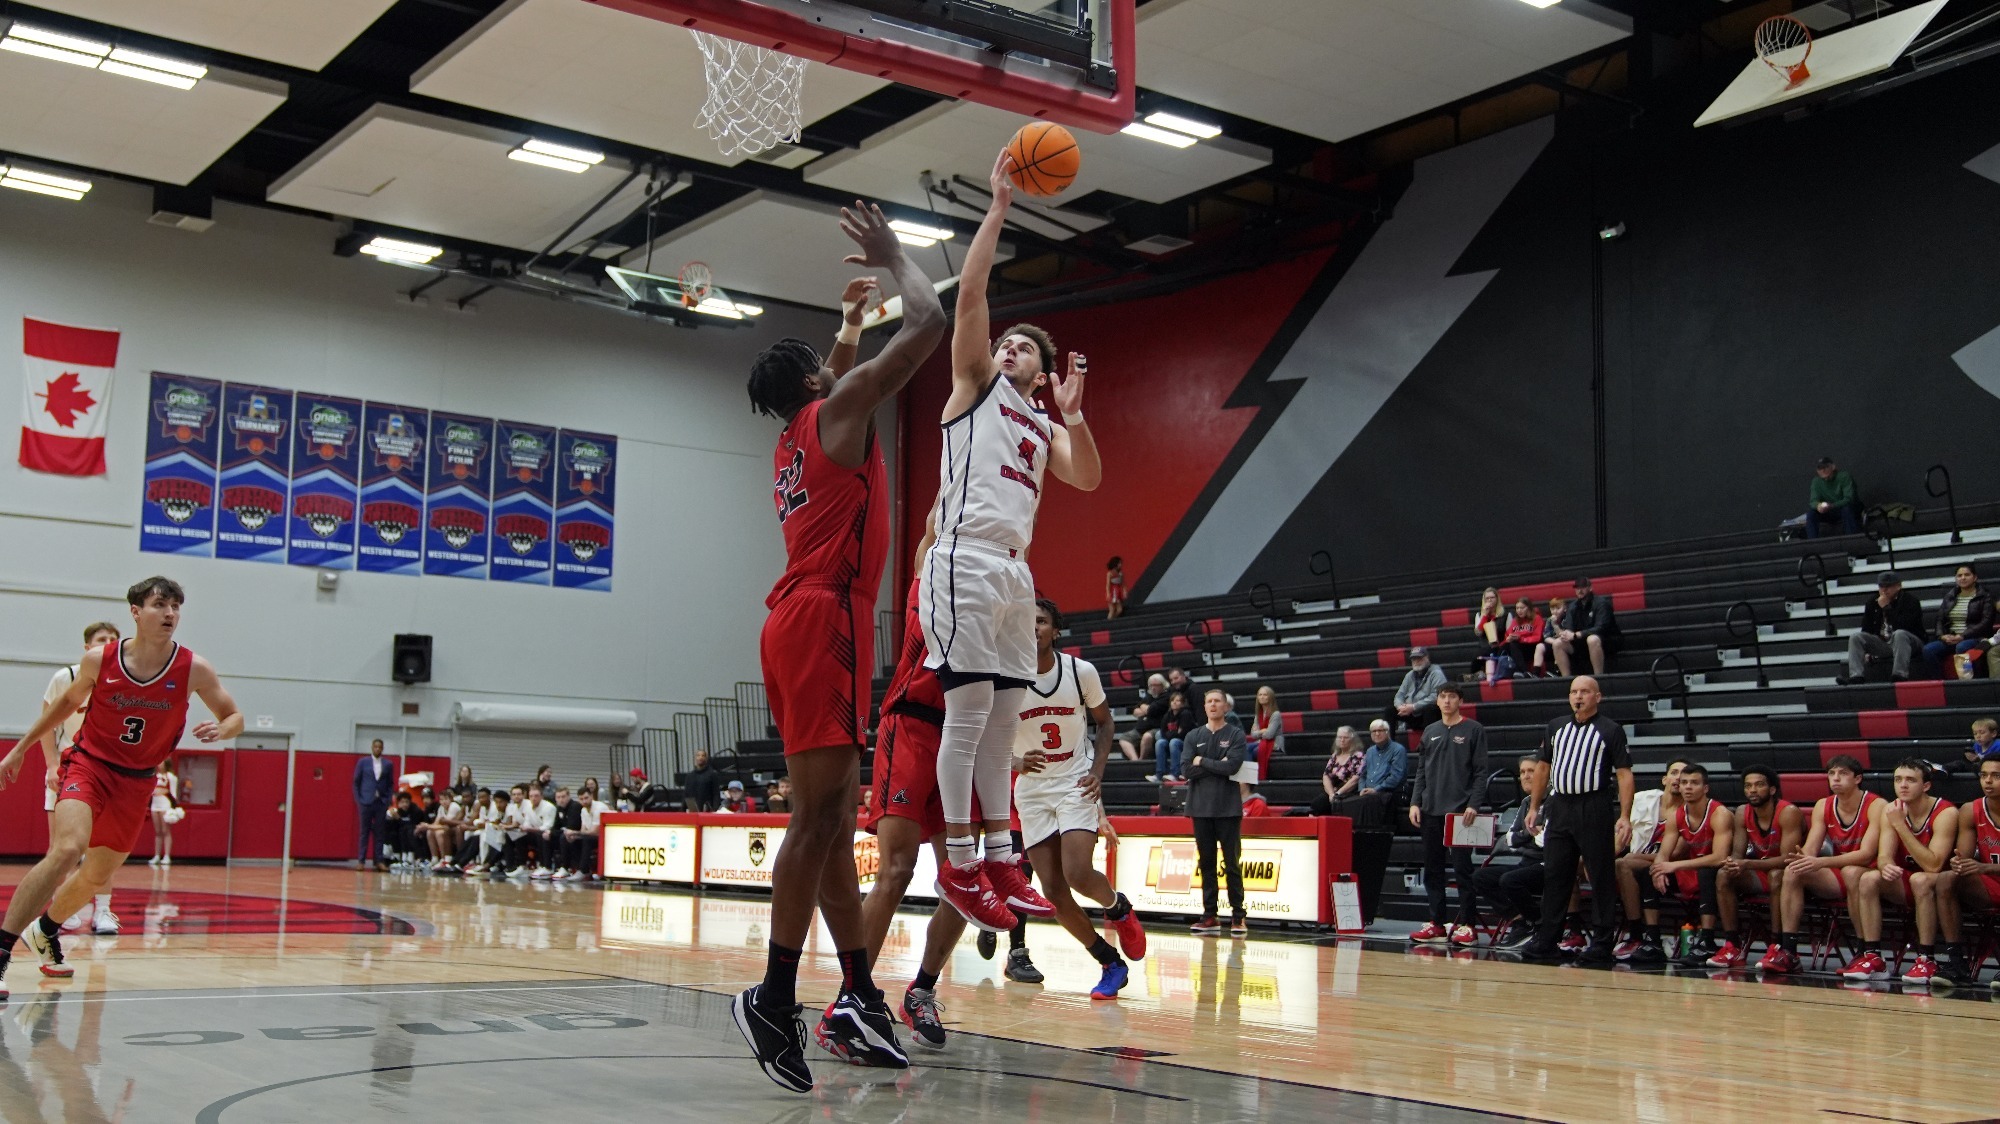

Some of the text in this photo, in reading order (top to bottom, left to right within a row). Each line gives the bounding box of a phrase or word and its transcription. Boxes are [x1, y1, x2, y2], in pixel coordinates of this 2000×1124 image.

[313, 411, 342, 425] gnac
[448, 430, 474, 442] gnac
[511, 437, 538, 449] gnac
[447, 446, 474, 457] FINAL
[574, 446, 600, 459] gnac
[448, 455, 474, 466] FOUR
[574, 463, 602, 473] SWEET
[143, 524, 211, 540] WESTERN OREGON
[219, 532, 284, 546] WESTERN OREGON
[291, 539, 353, 552] WESTERN OREGON
[360, 546, 419, 559] WESTERN OREGON
[428, 550, 485, 563] WESTERN OREGON
[494, 556, 548, 569] WESTERN OREGON
[557, 563, 610, 576] WESTERN OREGON
[1019, 706, 1075, 721] WESTERN
[119, 716, 146, 745] 3
[1041, 723, 1062, 749] 3
[622, 845, 666, 874] maps
[1161, 848, 1194, 878] Tires
[704, 868, 773, 882] WOLVESLOCKERR
[1164, 898, 1202, 909] supporte
[1250, 900, 1290, 913] Athletics
